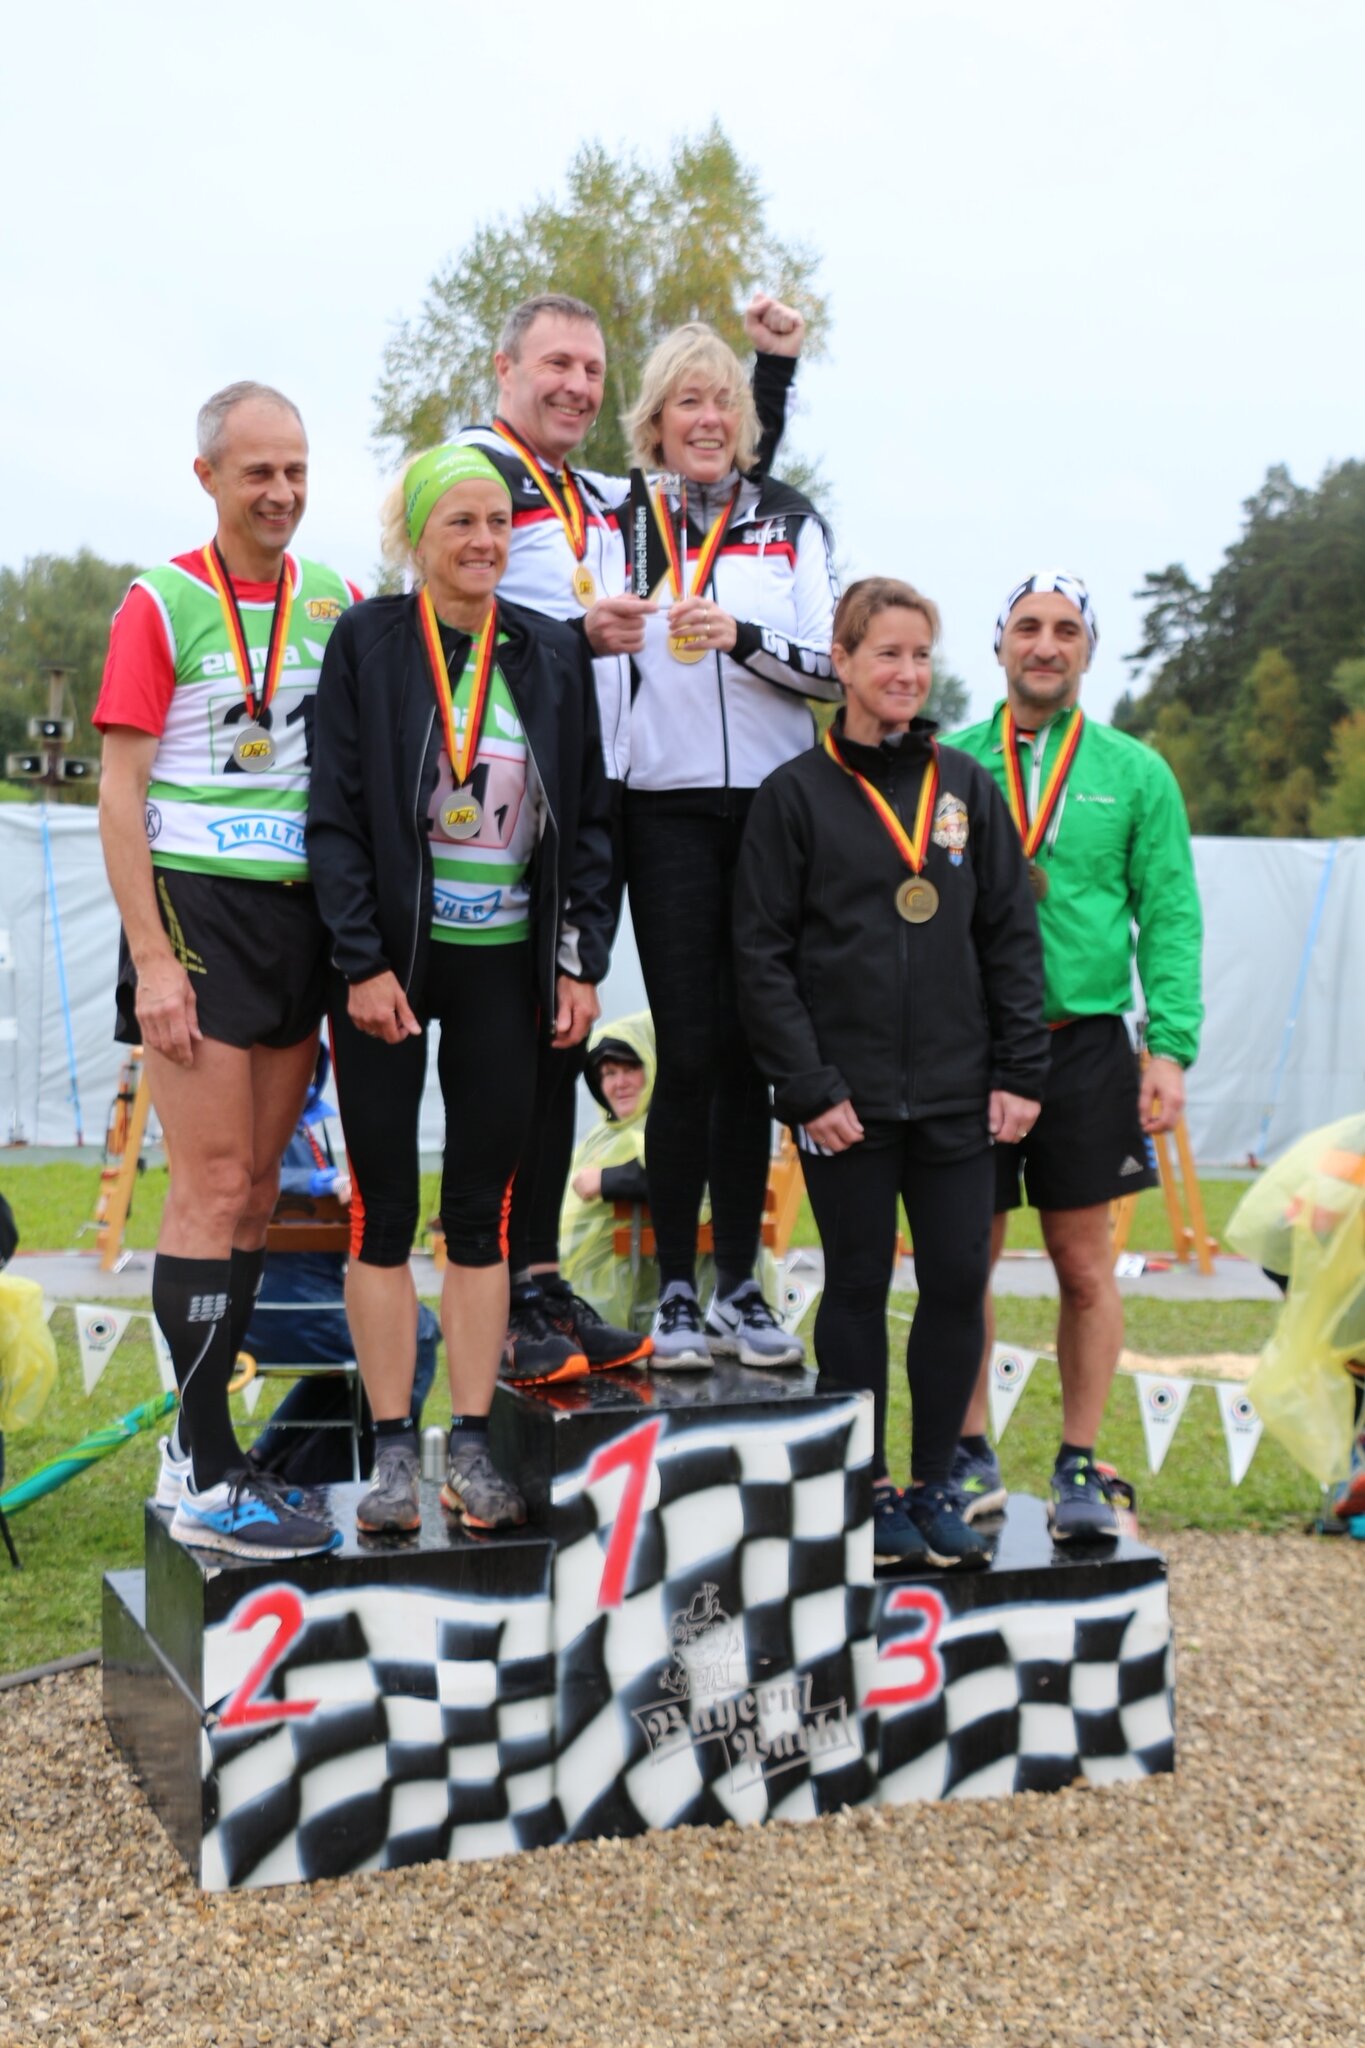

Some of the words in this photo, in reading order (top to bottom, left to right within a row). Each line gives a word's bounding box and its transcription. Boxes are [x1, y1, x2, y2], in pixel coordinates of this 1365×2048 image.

[584, 1416, 664, 1609] 1
[214, 1588, 320, 1730] 2
[861, 1588, 944, 1709] 3
